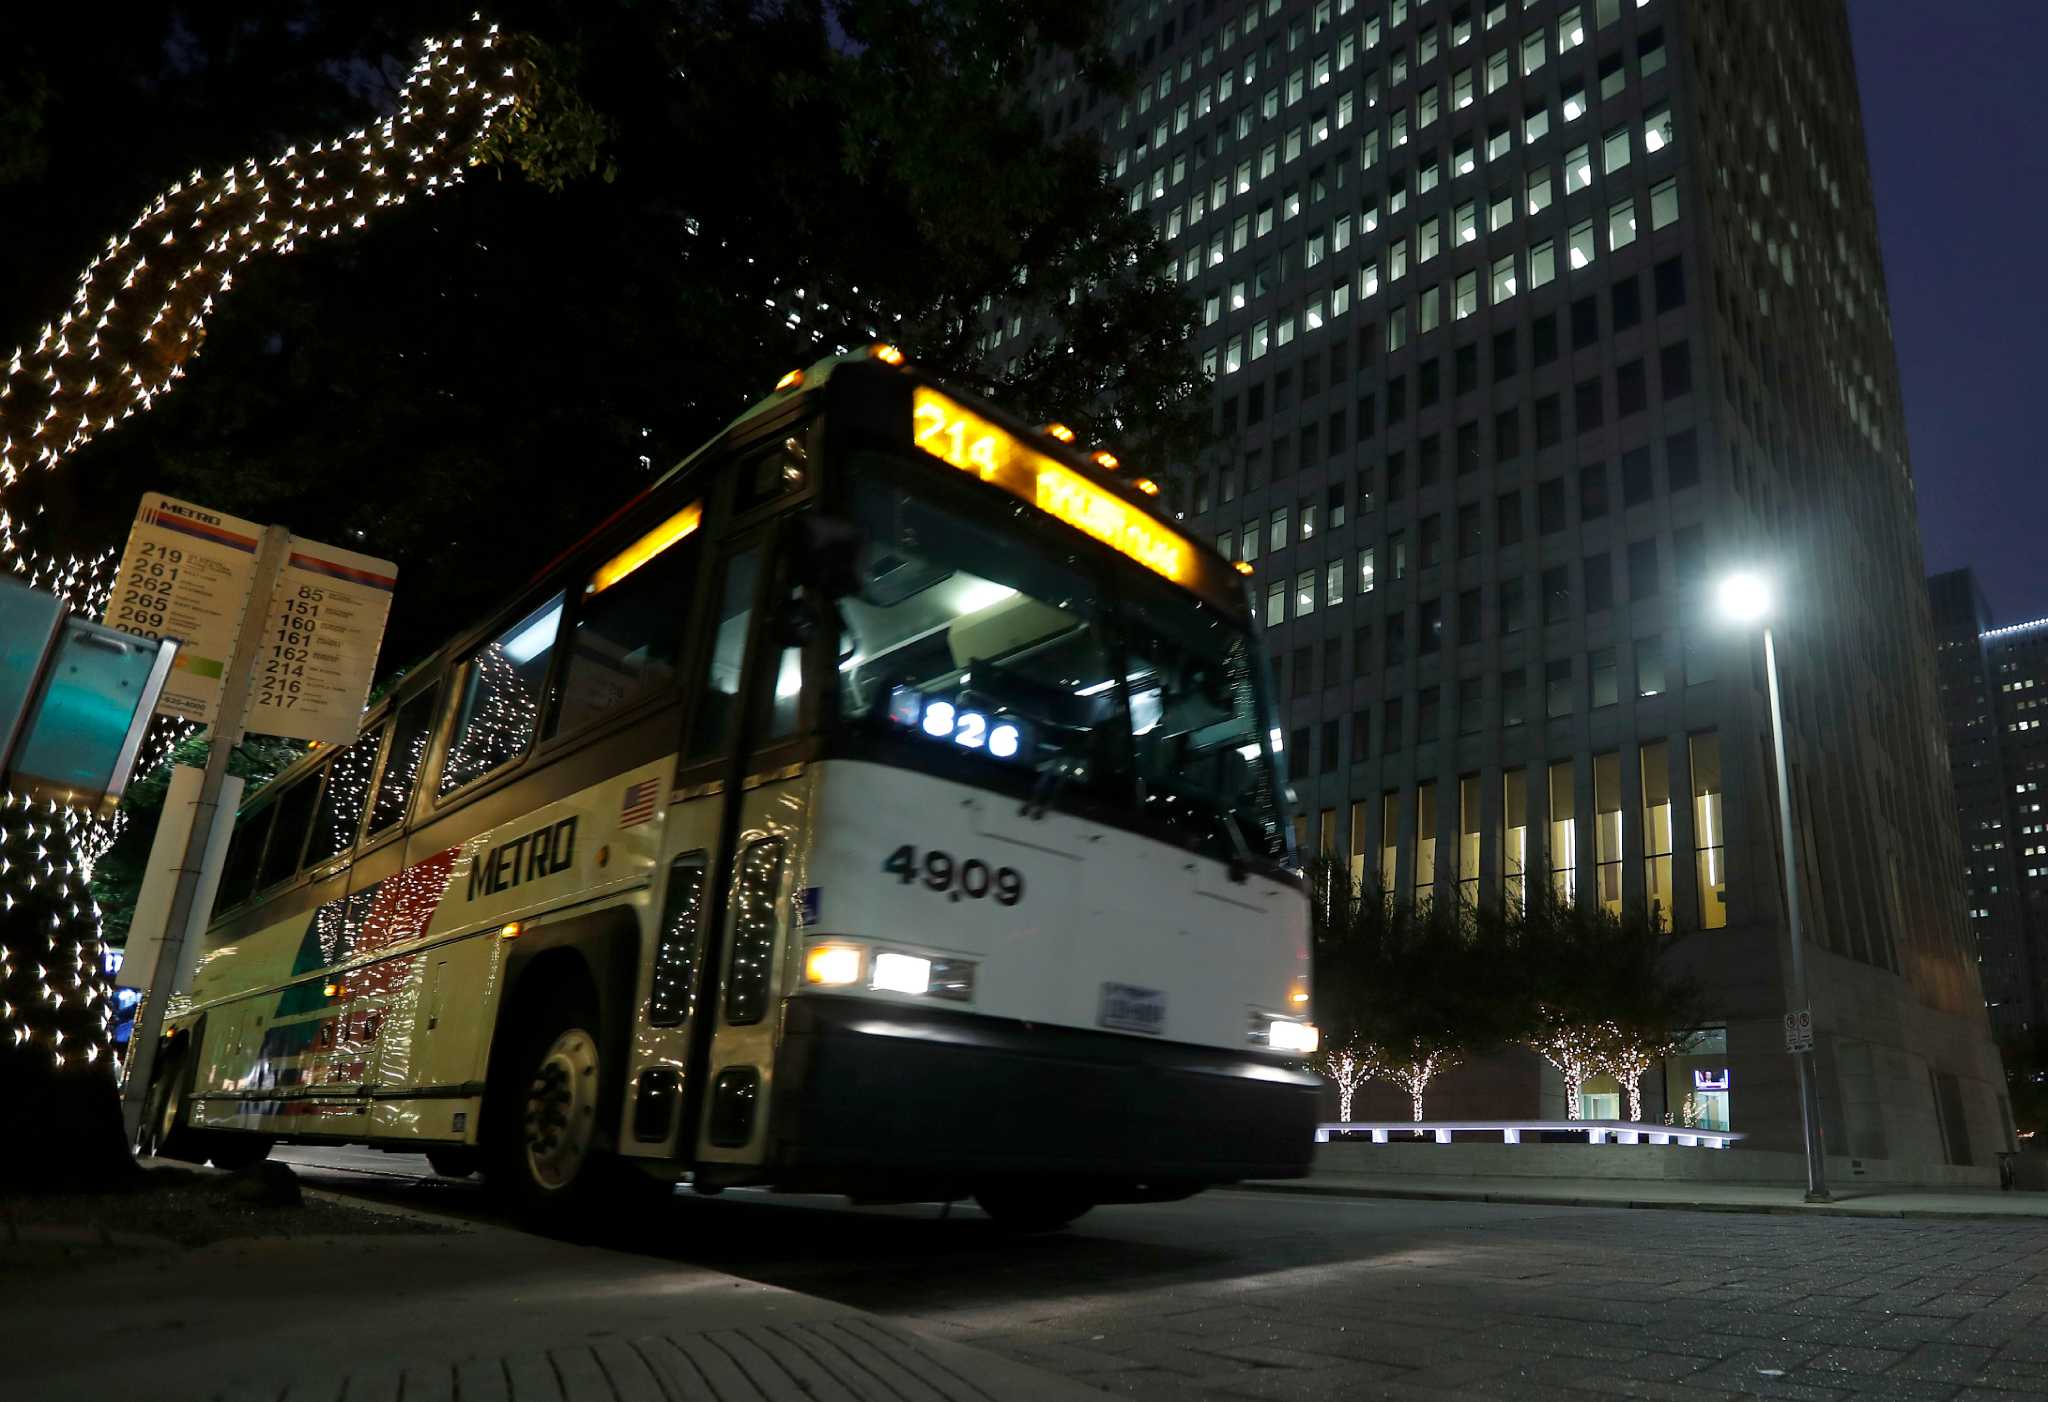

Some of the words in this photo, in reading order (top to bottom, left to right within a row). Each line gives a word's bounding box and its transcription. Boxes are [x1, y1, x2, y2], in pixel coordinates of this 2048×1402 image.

[160, 501, 221, 526] METRO
[141, 542, 182, 564] 219
[133, 558, 178, 581] 261
[128, 573, 172, 596] 262
[298, 585, 325, 602] 85
[123, 590, 167, 612] 265
[286, 599, 321, 617] 151
[118, 606, 163, 628] 269
[281, 614, 316, 632] 160
[277, 629, 312, 647] 161
[273, 645, 309, 663] 162
[266, 660, 304, 678] 214
[262, 675, 302, 694] 216
[259, 691, 299, 709] 217
[922, 701, 1020, 757] 826
[466, 814, 579, 902] METRO
[881, 843, 1026, 907] 4909
